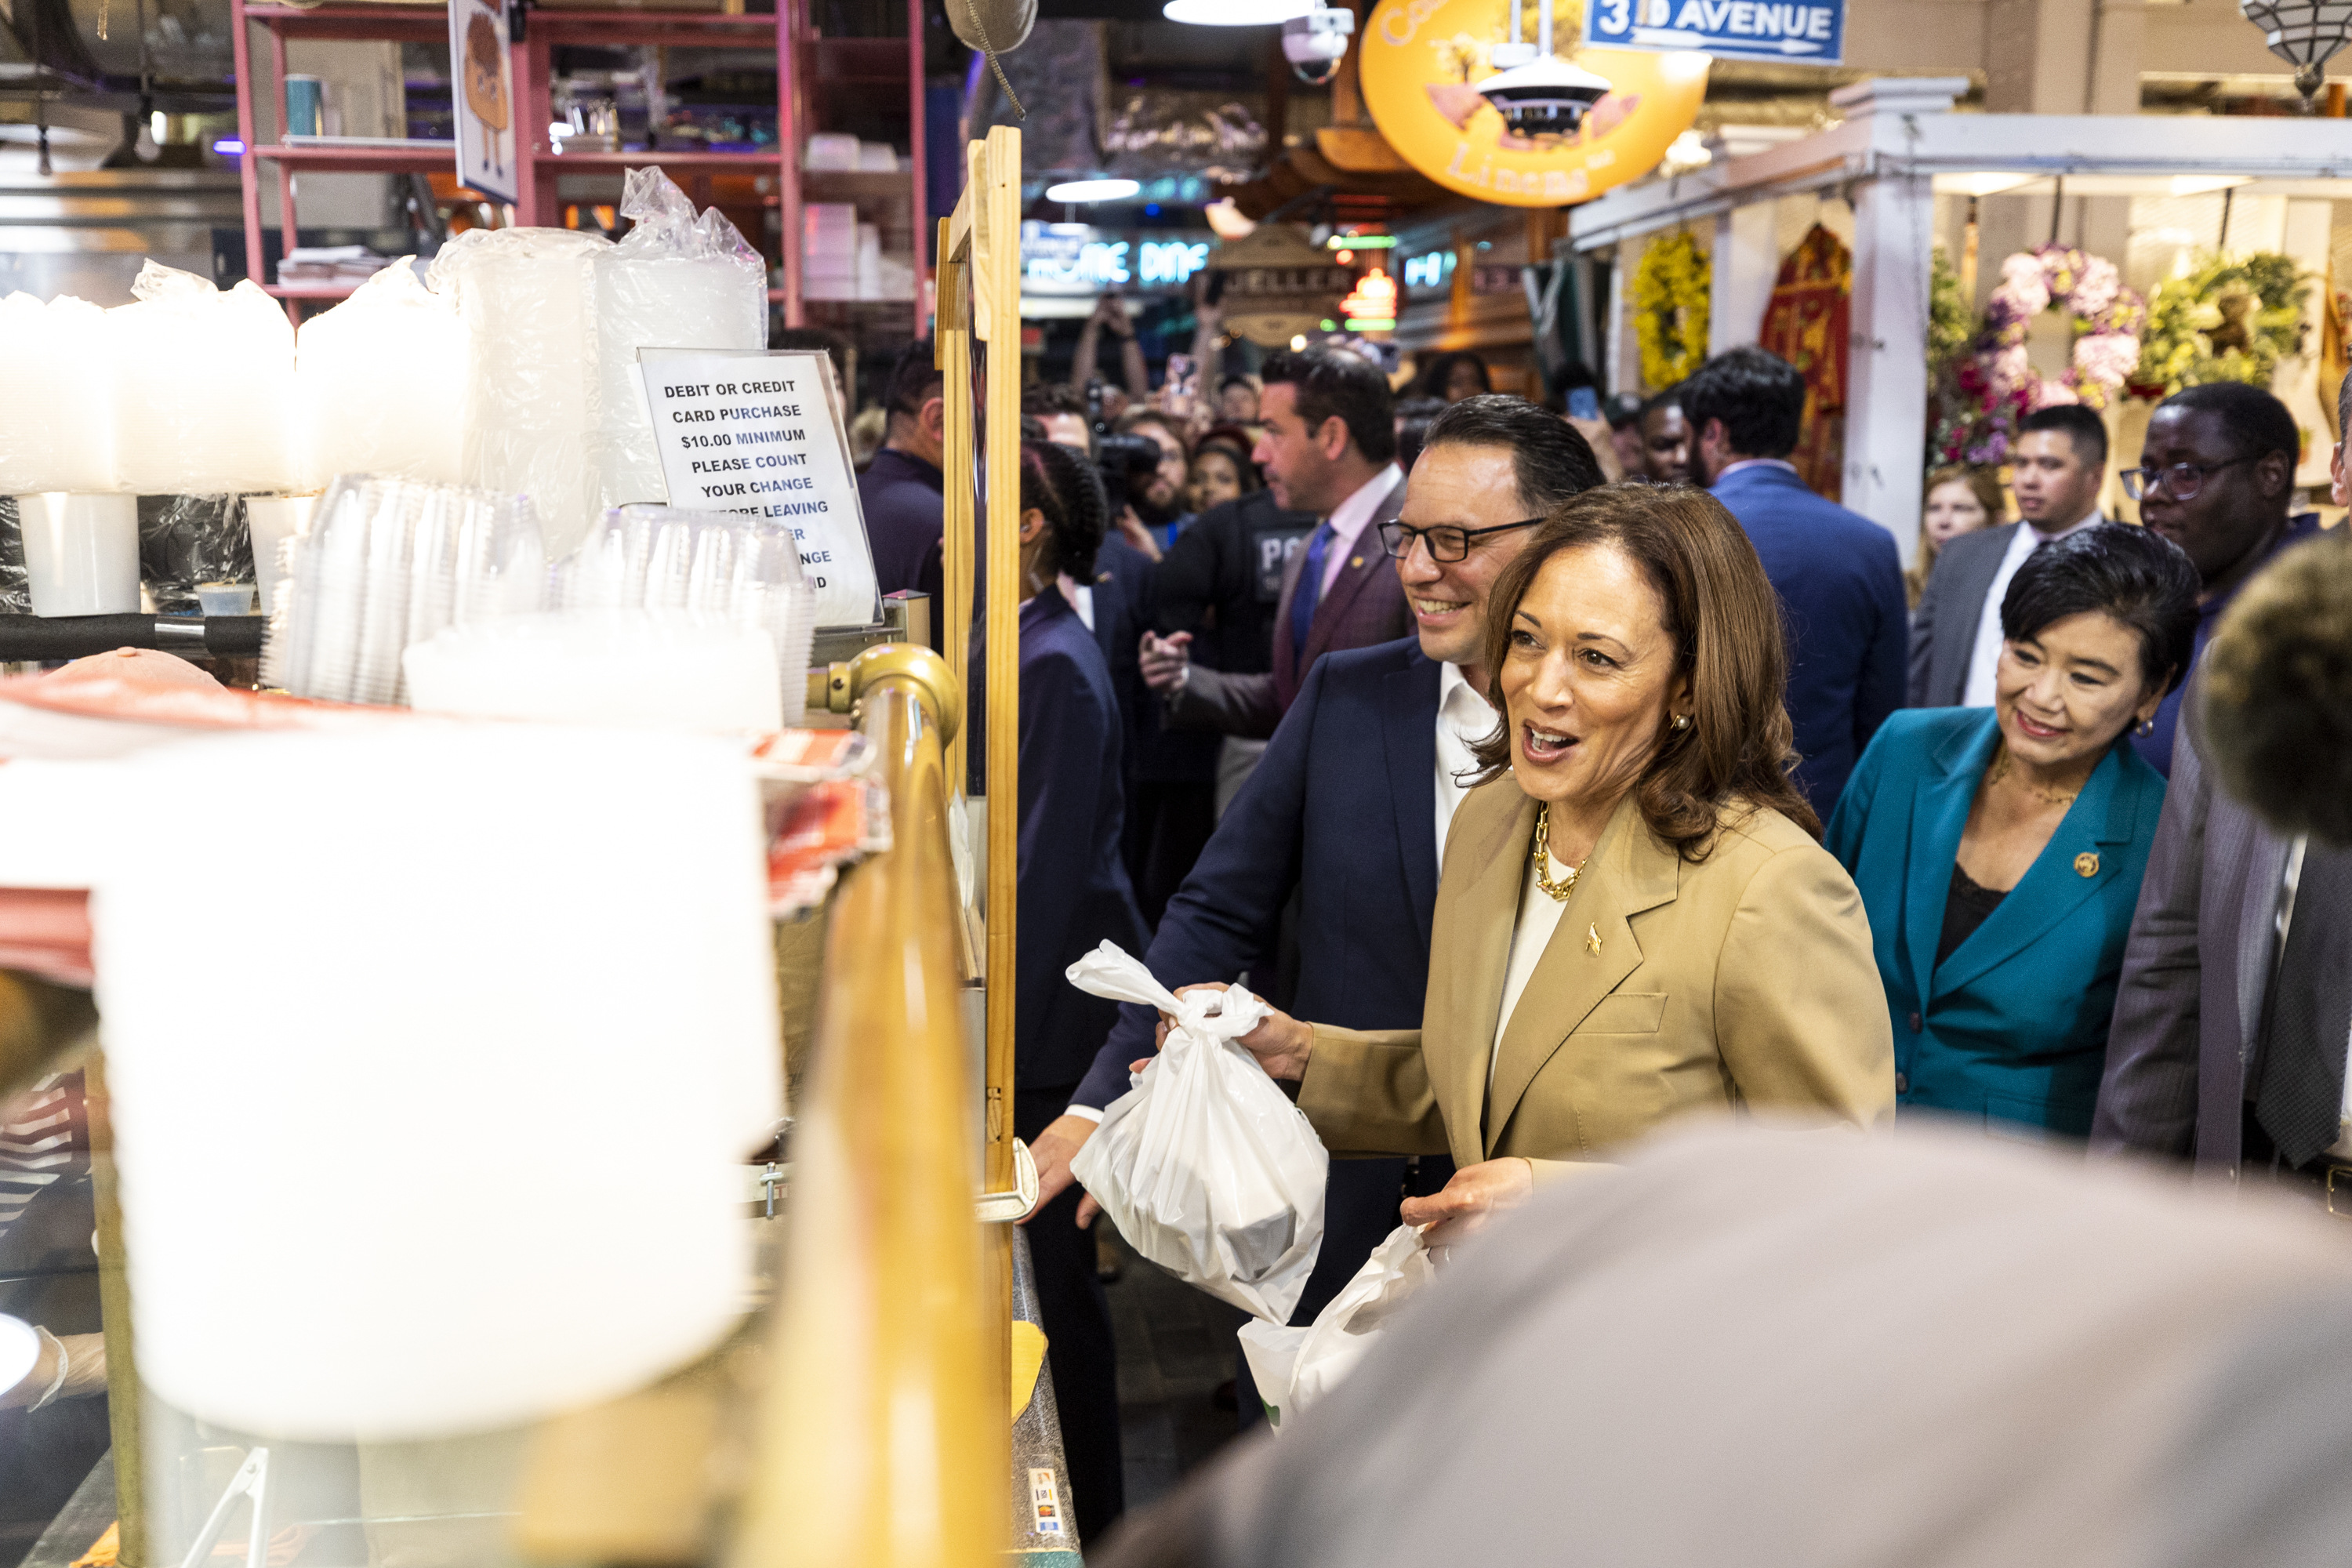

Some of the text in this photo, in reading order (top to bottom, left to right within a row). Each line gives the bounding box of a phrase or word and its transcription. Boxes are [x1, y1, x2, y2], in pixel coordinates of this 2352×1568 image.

[1674, 0, 1833, 39] AVENUE
[664, 380, 796, 398] DEBIT OR CREDIT
[672, 405, 801, 423] CARD PURCHASE
[681, 429, 806, 449] $10.00 MINIMUM
[691, 453, 808, 474] PLEASE COUNT
[700, 477, 813, 498] YOUR CHANGE
[764, 501, 829, 518] LEAVING
